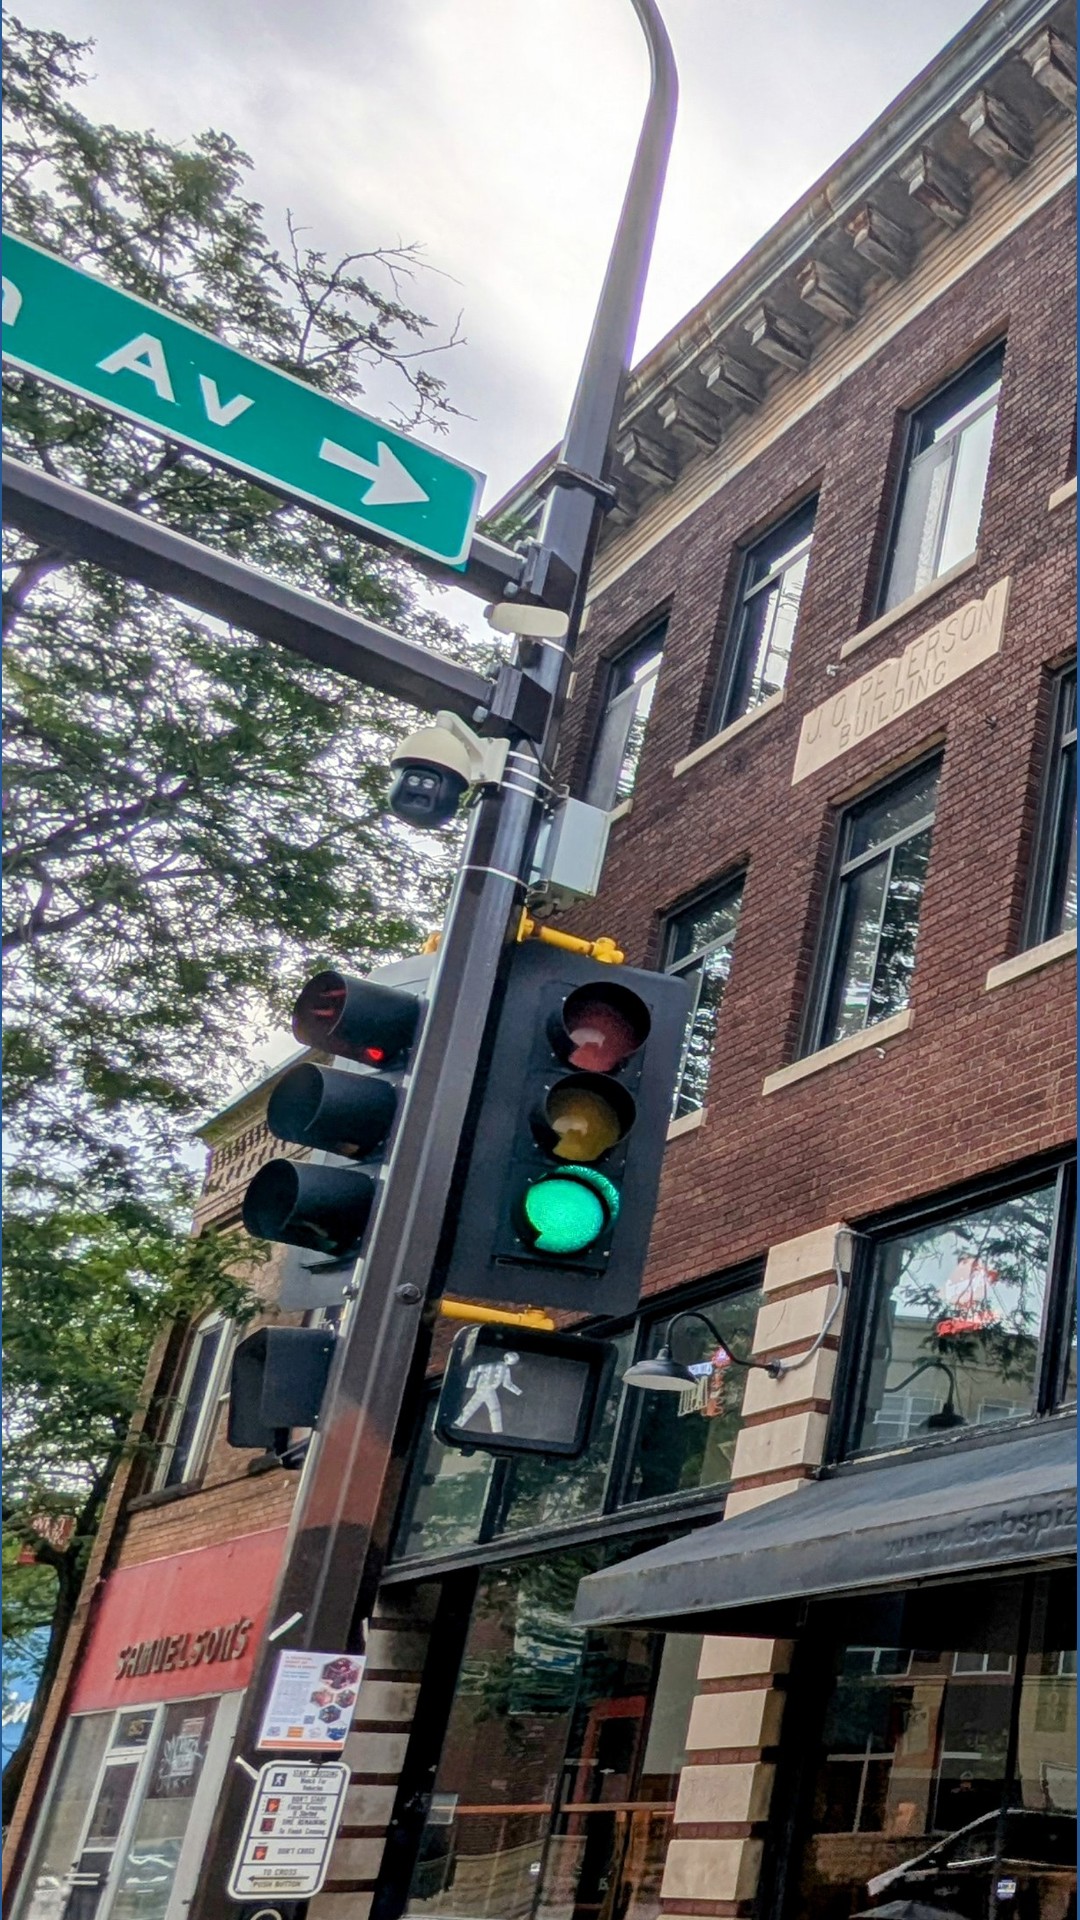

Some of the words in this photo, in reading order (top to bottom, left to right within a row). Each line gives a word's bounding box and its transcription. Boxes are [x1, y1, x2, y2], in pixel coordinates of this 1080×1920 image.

[96, 333, 255, 427] Av
[856, 589, 998, 715] PETERSON
[838, 660, 947, 750] BUILDING
